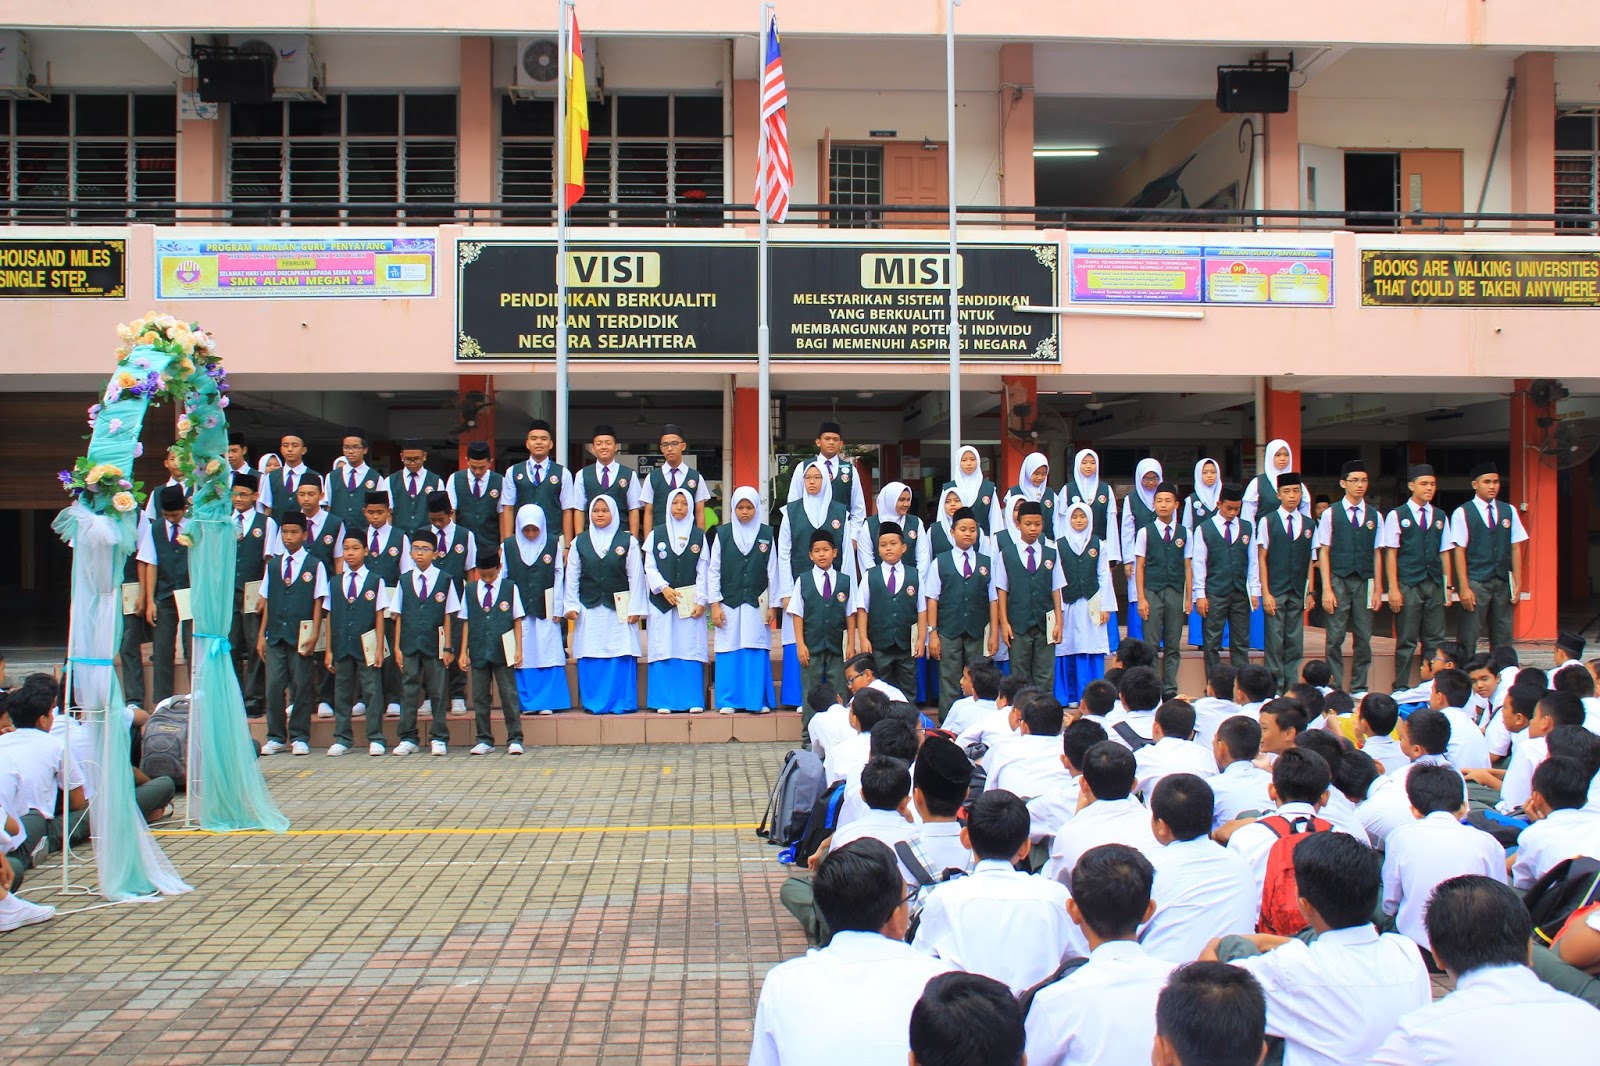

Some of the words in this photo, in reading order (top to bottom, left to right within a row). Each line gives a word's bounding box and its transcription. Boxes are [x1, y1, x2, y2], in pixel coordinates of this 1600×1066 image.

[256, 243, 296, 251] AMALAN
[331, 242, 386, 250] PENYAYANG
[71, 249, 111, 267] MILES
[573, 256, 644, 283] VISI
[874, 258, 950, 285] MISI
[1374, 260, 1418, 276] BOOKS
[1423, 260, 1449, 276] ARE
[1454, 260, 1511, 277] WALKING
[1516, 261, 1599, 277] UNIVERSITIES
[0, 270, 46, 287] SINGLE
[51, 270, 89, 287] STEP.
[230, 277, 257, 286] SMK
[263, 277, 299, 285] ALAM
[306, 276, 350, 285] MEGAH
[356, 276, 364, 284] 2
[1374, 280, 1406, 295] THAT
[1411, 280, 1454, 296] COULD
[1458, 281, 1475, 296] BE
[1480, 281, 1520, 296] TAKEN
[1525, 281, 1600, 297] ANYWHERE.
[616, 293, 716, 307] BERKUALITI
[793, 294, 892, 305] MELESTARIKAN
[897, 294, 944, 305] SISTEM
[949, 295, 1030, 306] ENDIDIKAN
[829, 308, 865, 320] YANG
[870, 309, 945, 320] BERKUALITI
[950, 309, 995, 320] NTUK
[536, 315, 590, 328] INAN
[597, 315, 678, 329] TERDIDIK
[791, 323, 906, 335] MEMBANGUNKAN
[972, 324, 1031, 335] INDIVIDU
[519, 334, 592, 348] NEGRA
[598, 334, 697, 349] SEJAHTERA
[796, 338, 827, 349] BAGI
[833, 338, 905, 349] MEMENUHI
[910, 339, 968, 350] ASPIRSI
[974, 339, 1027, 350] NEGARA
